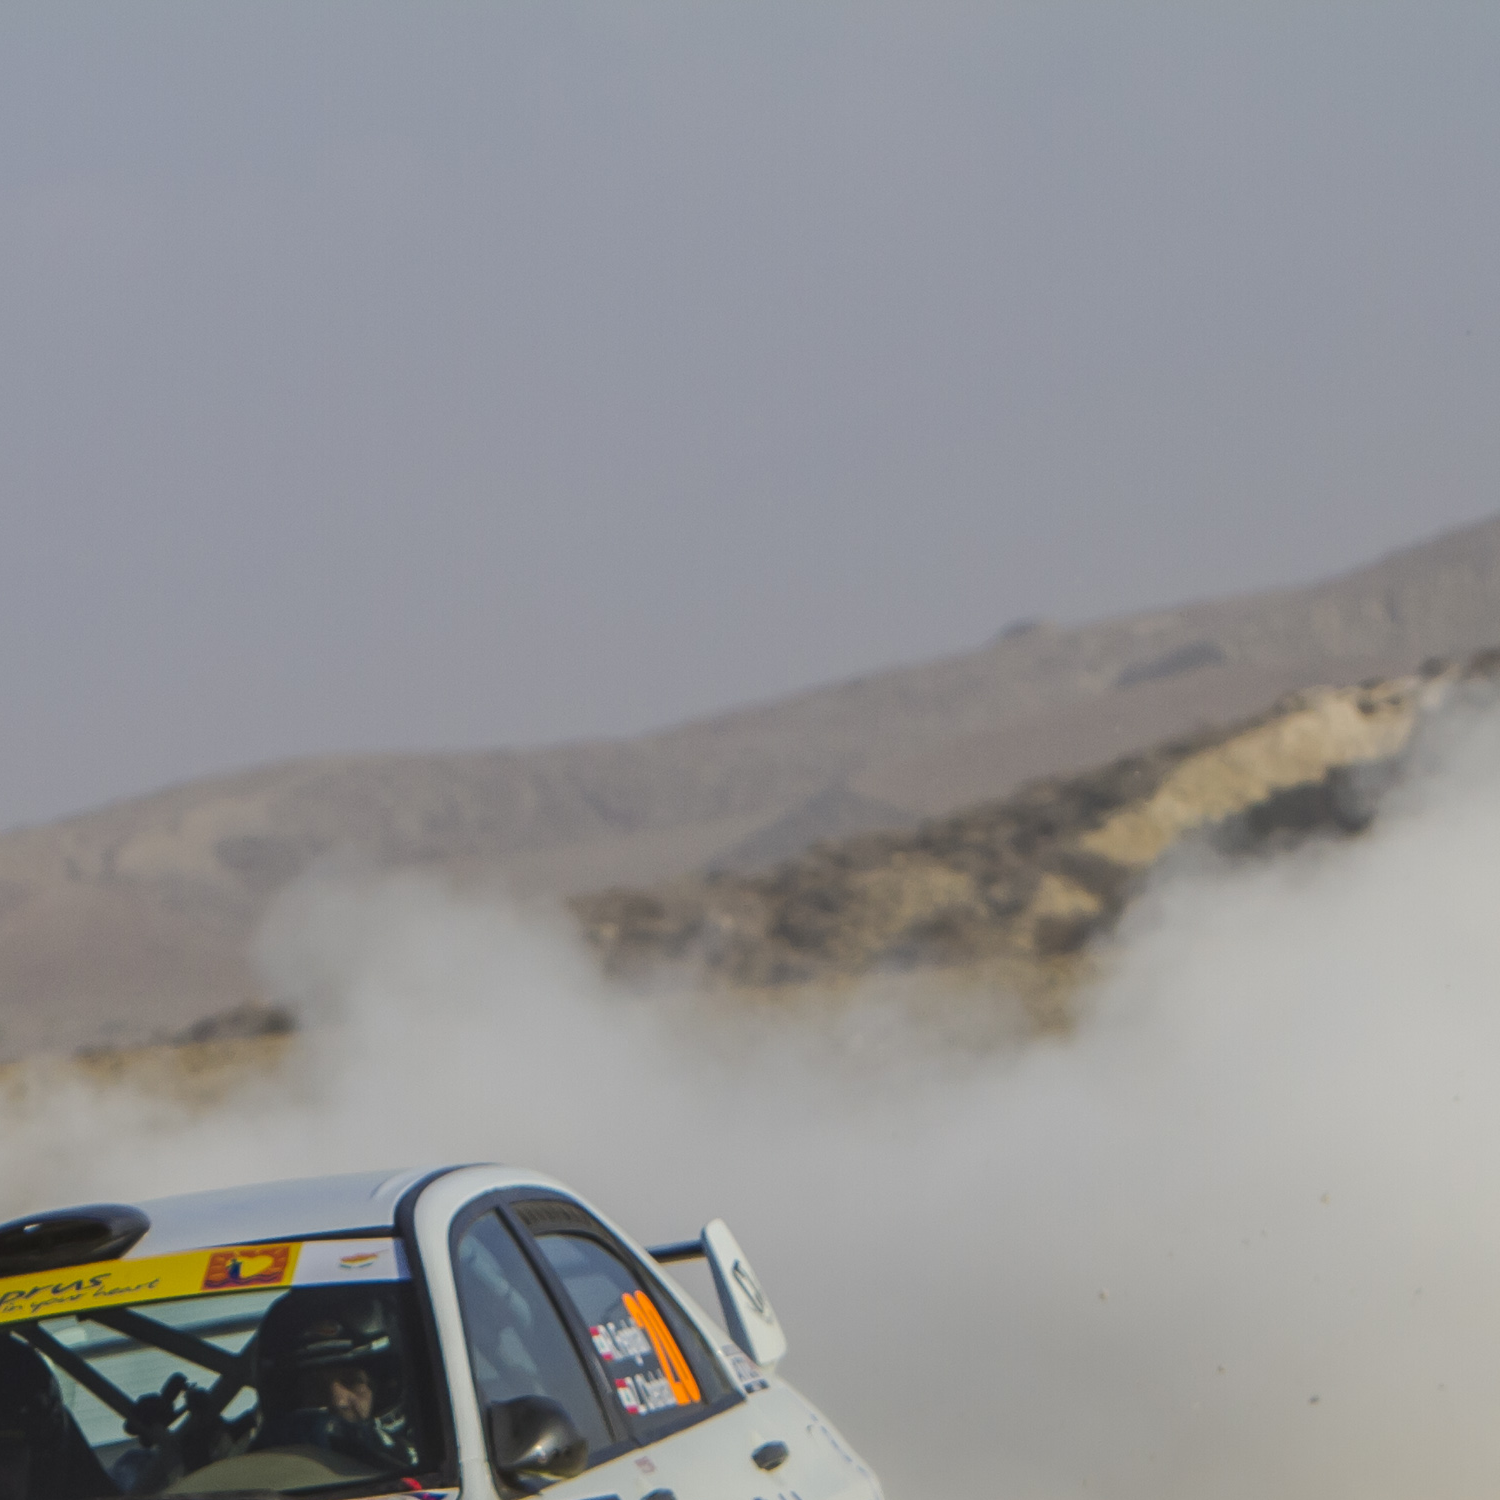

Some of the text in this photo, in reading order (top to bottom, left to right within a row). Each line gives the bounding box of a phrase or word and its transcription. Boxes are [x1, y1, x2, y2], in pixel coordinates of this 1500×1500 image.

[30, 1293, 86, 1314] your
[93, 1277, 161, 1299] heart
[622, 1290, 701, 1405] 20
